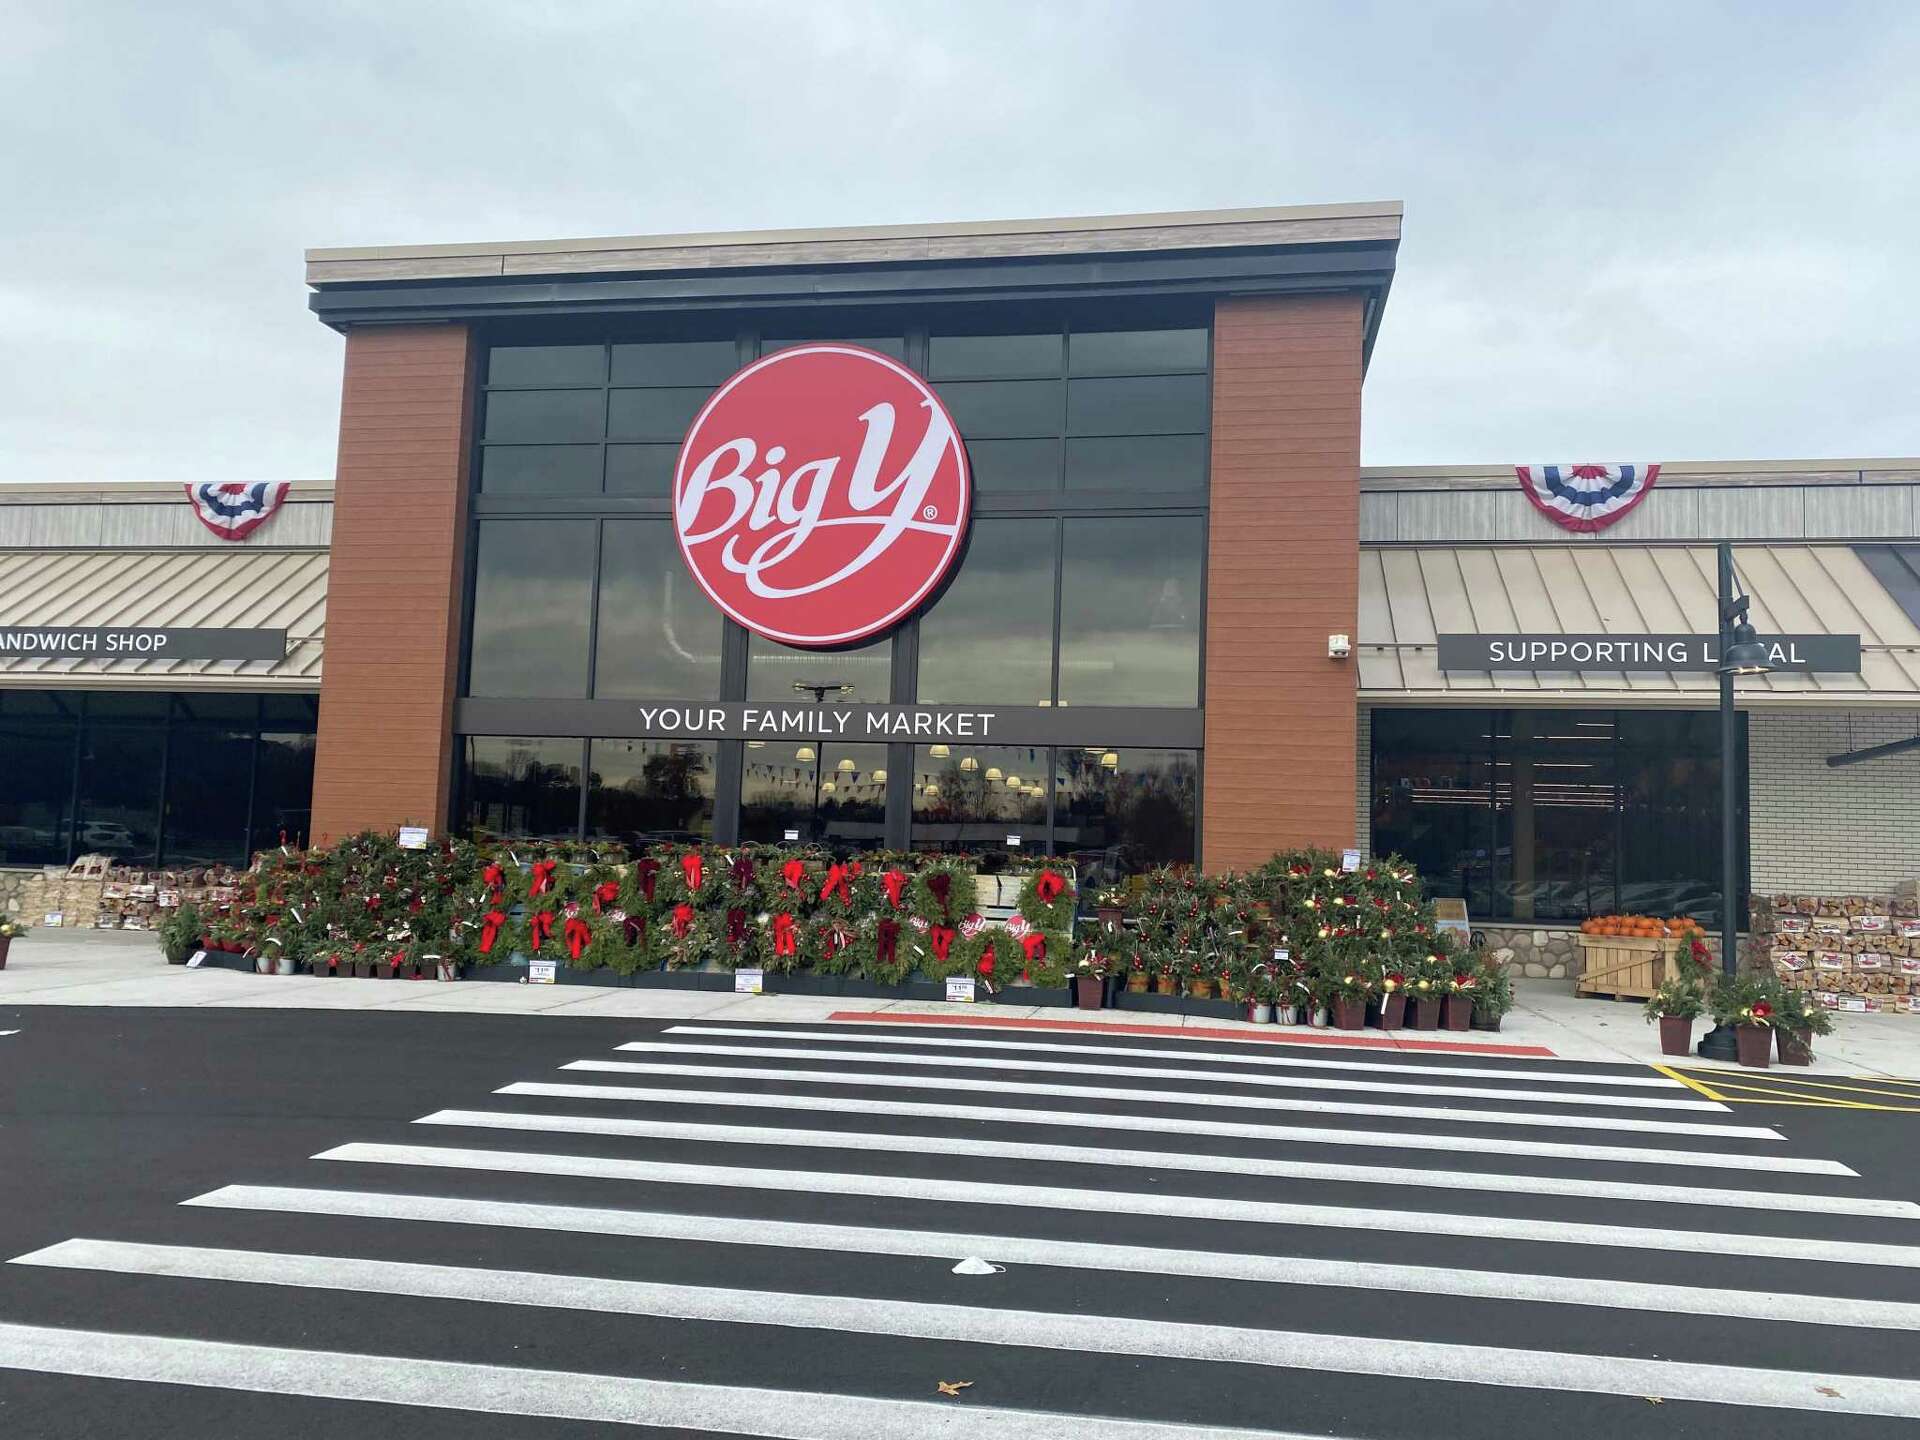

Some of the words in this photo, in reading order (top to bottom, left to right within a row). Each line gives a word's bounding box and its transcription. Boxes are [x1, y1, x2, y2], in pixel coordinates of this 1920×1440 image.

[679, 437, 841, 574] Big
[105, 634, 168, 652] SHOP
[1489, 641, 1688, 664] SUPPORTING
[1703, 642, 1806, 663] LAL
[639, 708, 726, 731] YOUR
[742, 709, 852, 734] FAMILY
[866, 711, 996, 736] MARKET
